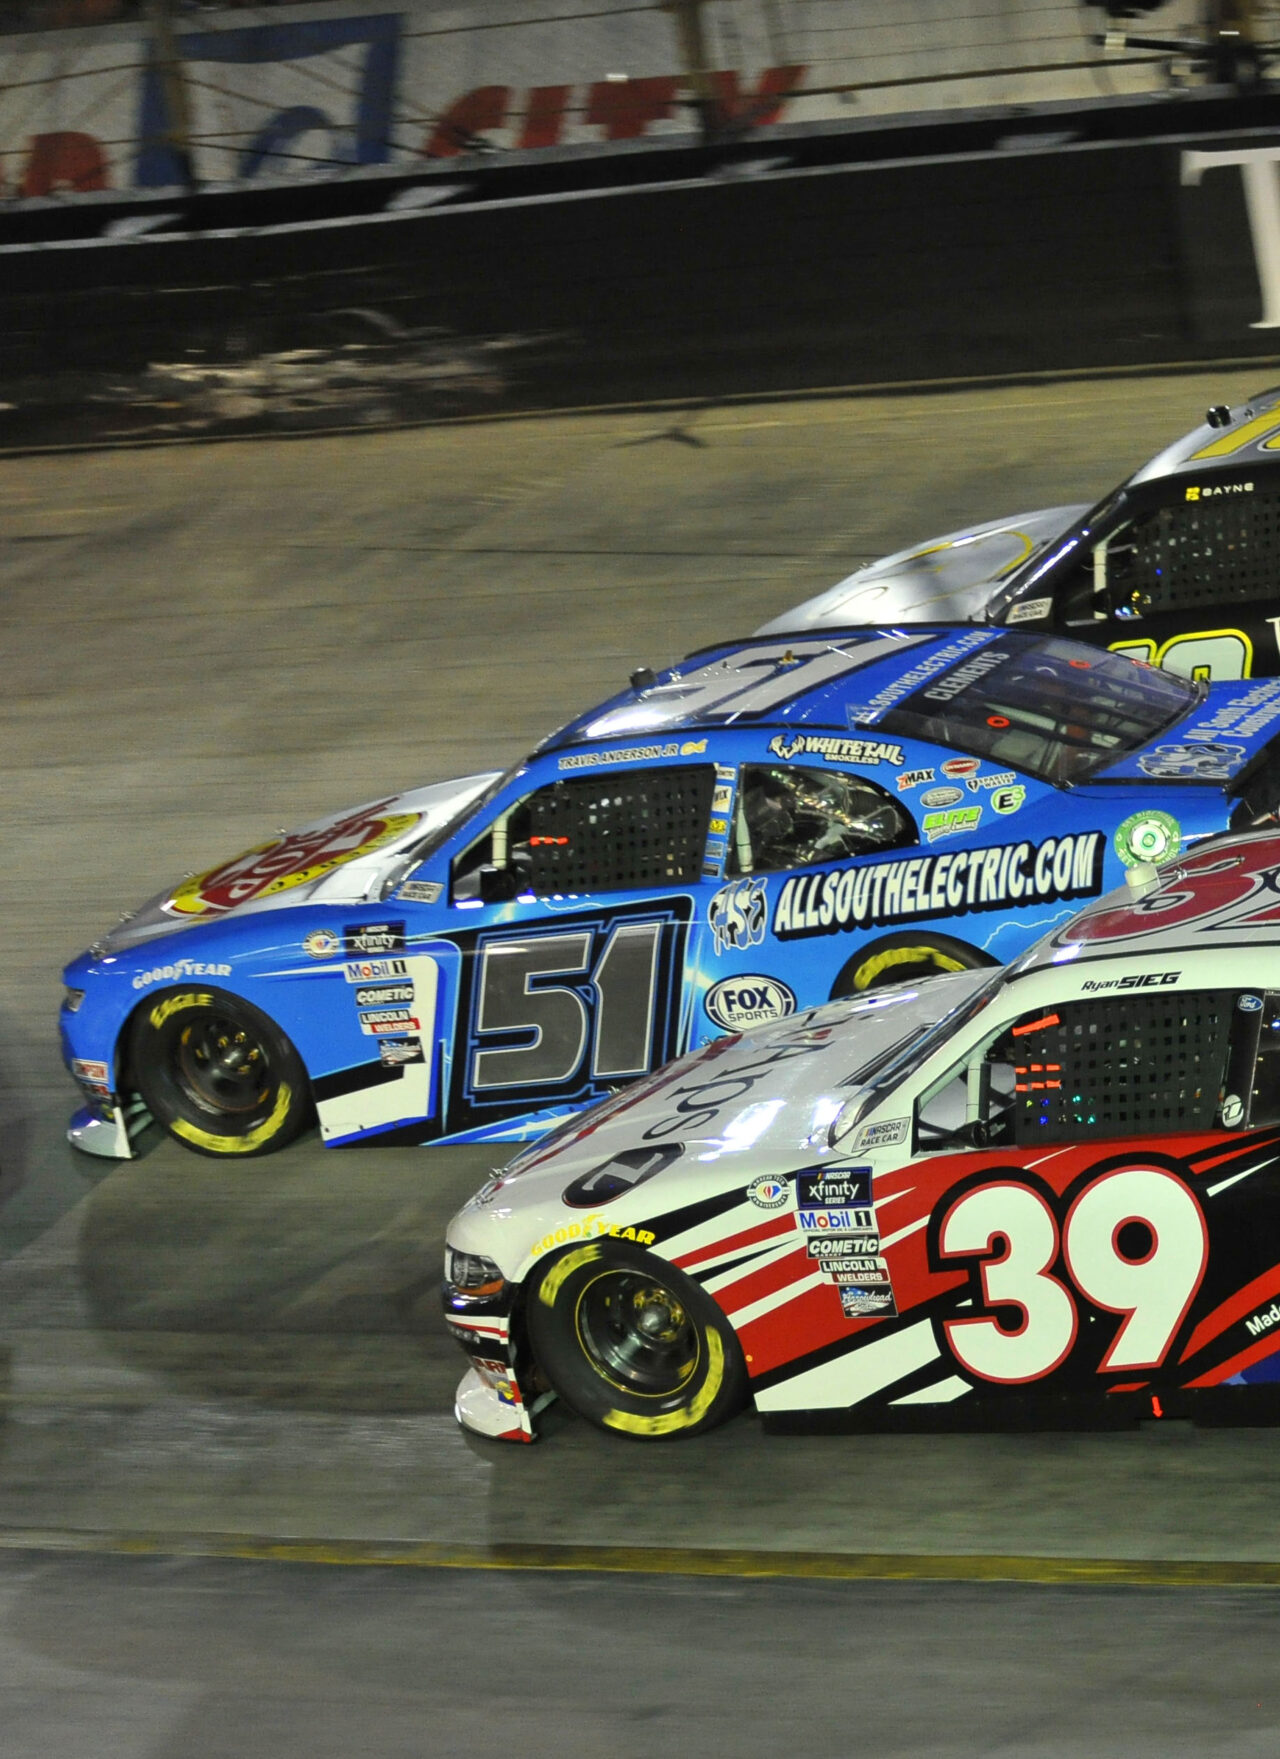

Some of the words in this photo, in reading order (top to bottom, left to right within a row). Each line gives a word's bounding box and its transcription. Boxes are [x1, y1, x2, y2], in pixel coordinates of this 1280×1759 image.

[1202, 482, 1254, 497] BAYNE
[924, 651, 1011, 701] CLEMENTS
[558, 753, 599, 770] TRAVIS
[600, 746, 661, 765] ANDERSON
[662, 744, 680, 757] JR
[806, 738, 906, 766] WHITETAIL
[924, 807, 979, 829] ELITE
[773, 832, 1101, 932] ALLSOUTHELECTRIC.COM
[348, 962, 390, 978] Mobil
[472, 922, 664, 1090] 51
[723, 985, 773, 1012] FOX
[362, 1011, 409, 1024] LINCOLN
[728, 1007, 779, 1022] SPORTS
[375, 1021, 416, 1033] WELDERS
[871, 1123, 901, 1135] NASCAR
[860, 1135, 881, 1147] RACE
[881, 1133, 899, 1144] CAR
[809, 1180, 860, 1201] xfinity
[825, 1196, 846, 1205] SERIES
[799, 1211, 851, 1229] Mobil
[809, 1236, 878, 1255] COMETIC
[822, 1260, 875, 1272] LINCOLN
[938, 1163, 1210, 1385] 39
[837, 1272, 883, 1282] WELDERS
